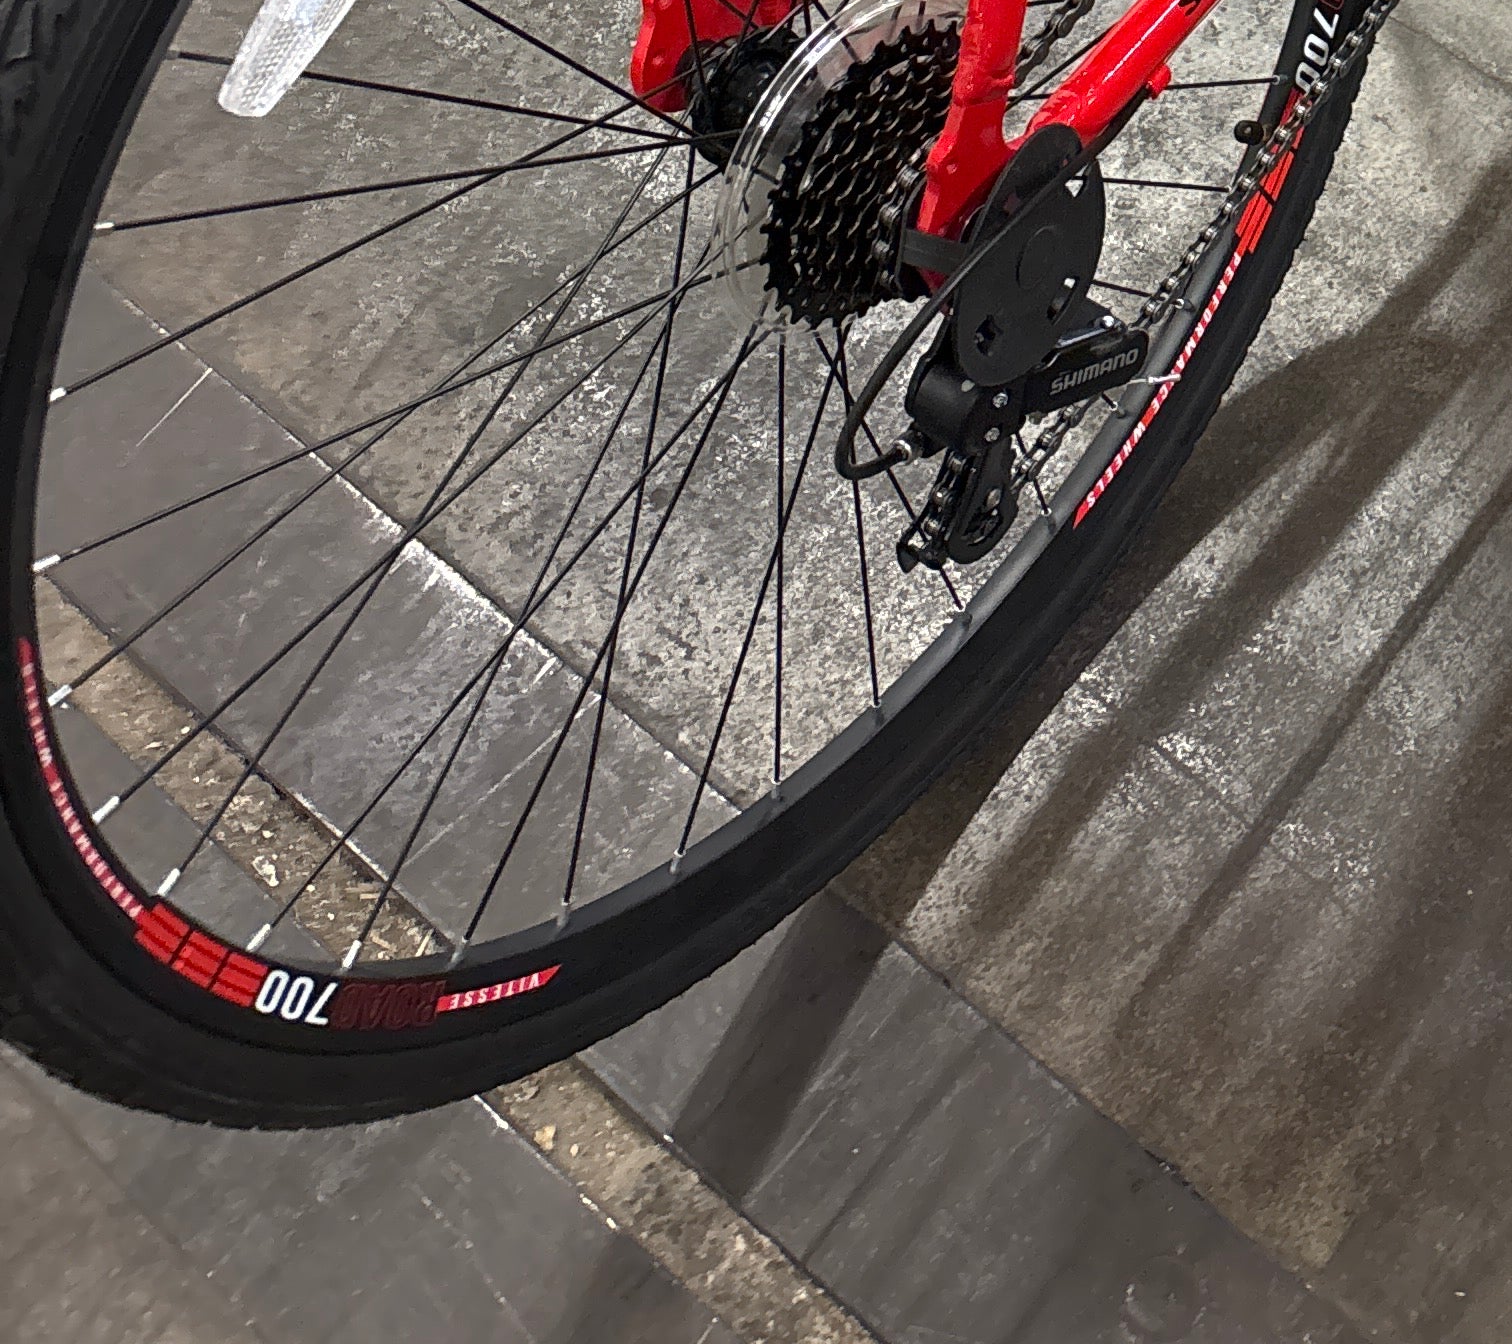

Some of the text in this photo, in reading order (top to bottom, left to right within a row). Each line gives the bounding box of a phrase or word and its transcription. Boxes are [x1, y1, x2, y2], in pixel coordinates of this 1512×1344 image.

[1295, 8, 1339, 94] 700
[1150, 252, 1242, 411] PERFORMACE
[1050, 348, 1139, 396] SHIMANO
[1086, 421, 1147, 507] WHEELS
[254, 969, 338, 1026] 700
[450, 972, 540, 1010] VITESSE
